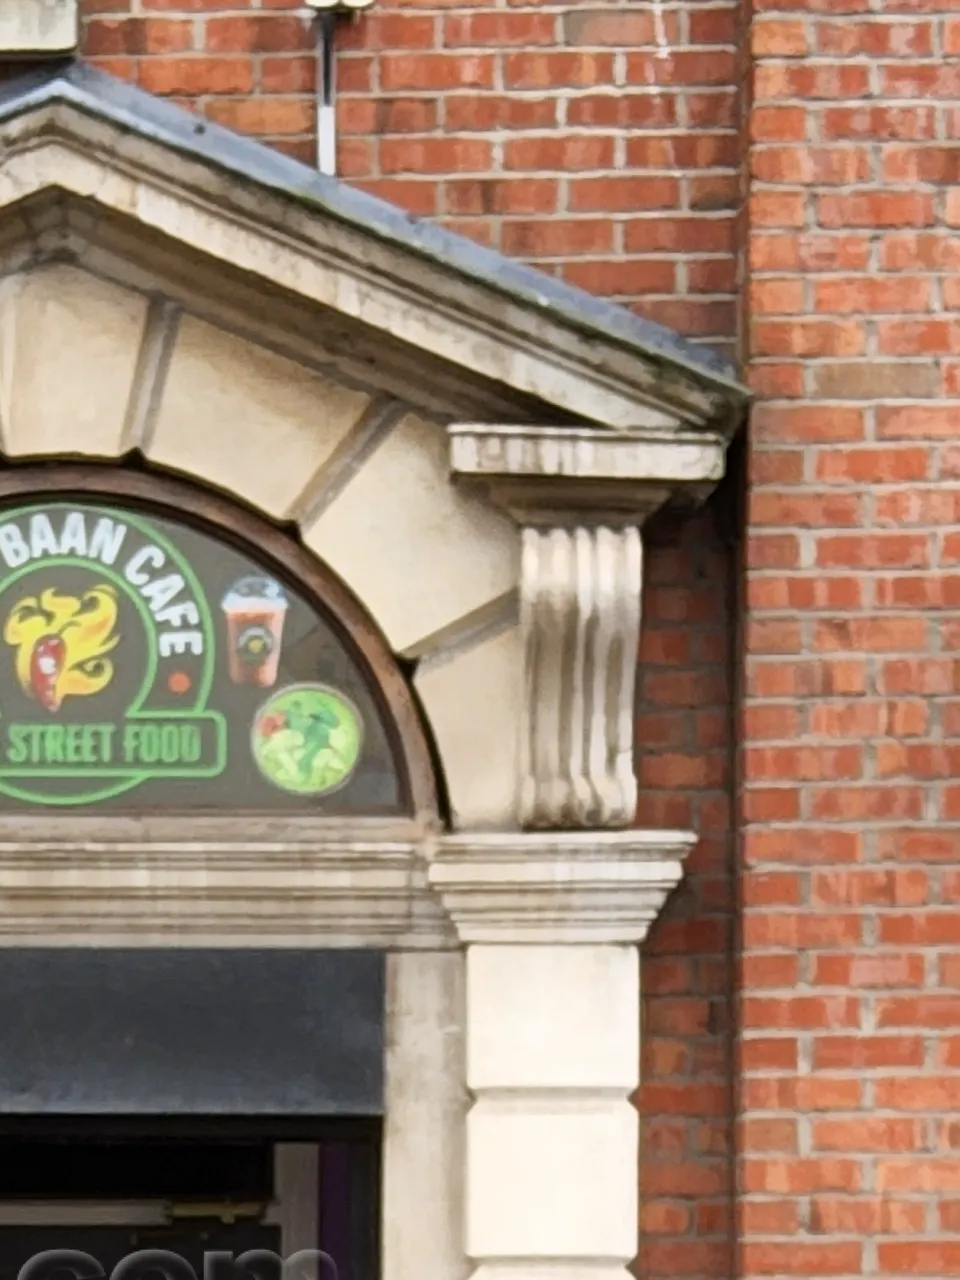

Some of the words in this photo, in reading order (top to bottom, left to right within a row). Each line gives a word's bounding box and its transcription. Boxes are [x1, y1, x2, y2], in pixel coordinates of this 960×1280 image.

[125, 546, 203, 657] CAFE
[7, 723, 115, 763] STREET
[124, 723, 200, 763] FOOD
